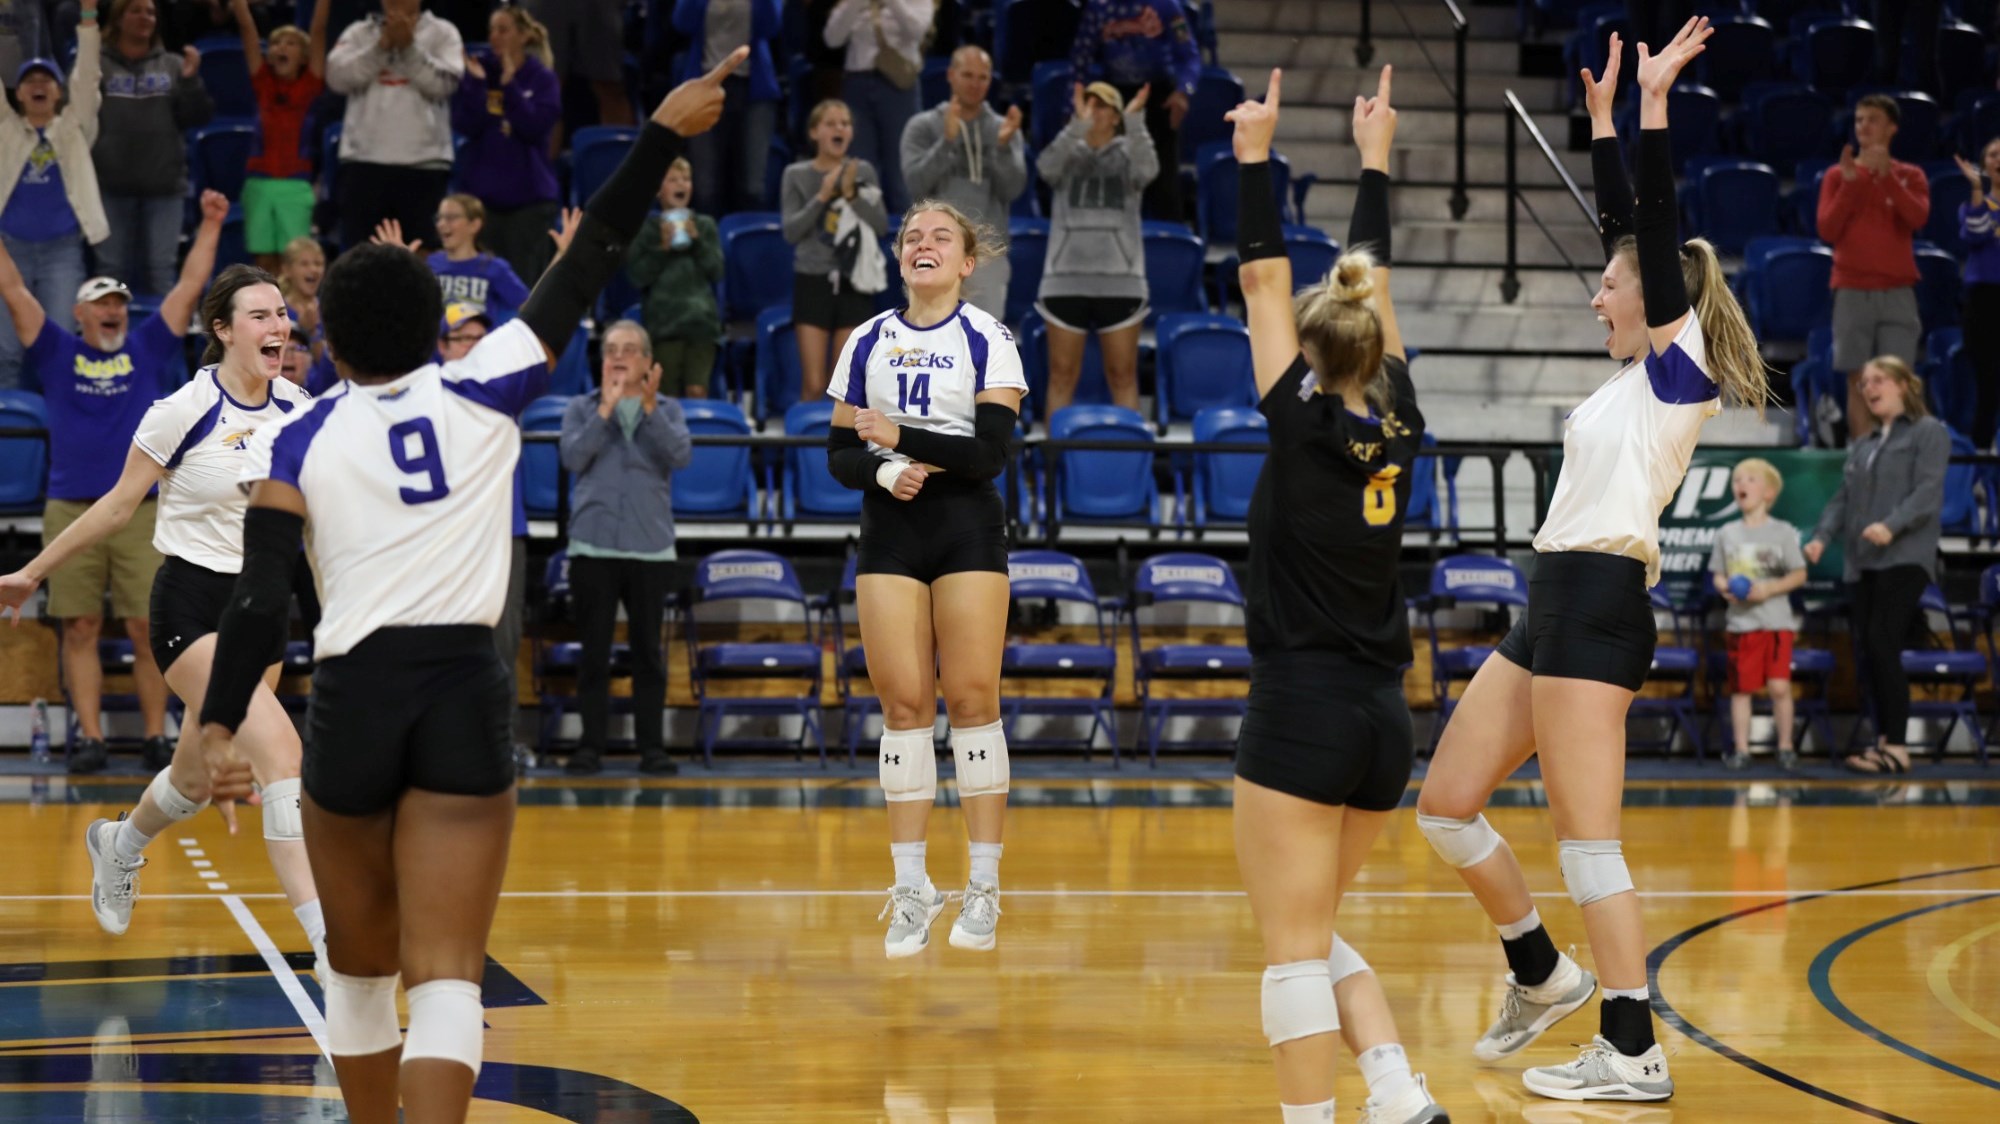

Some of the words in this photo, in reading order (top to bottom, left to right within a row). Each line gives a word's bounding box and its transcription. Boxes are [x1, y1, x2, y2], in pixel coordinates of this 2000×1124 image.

[439, 274, 489, 301] DSU
[896, 373, 931, 417] 14
[388, 416, 450, 506] 9
[1657, 527, 1716, 546] PREM
